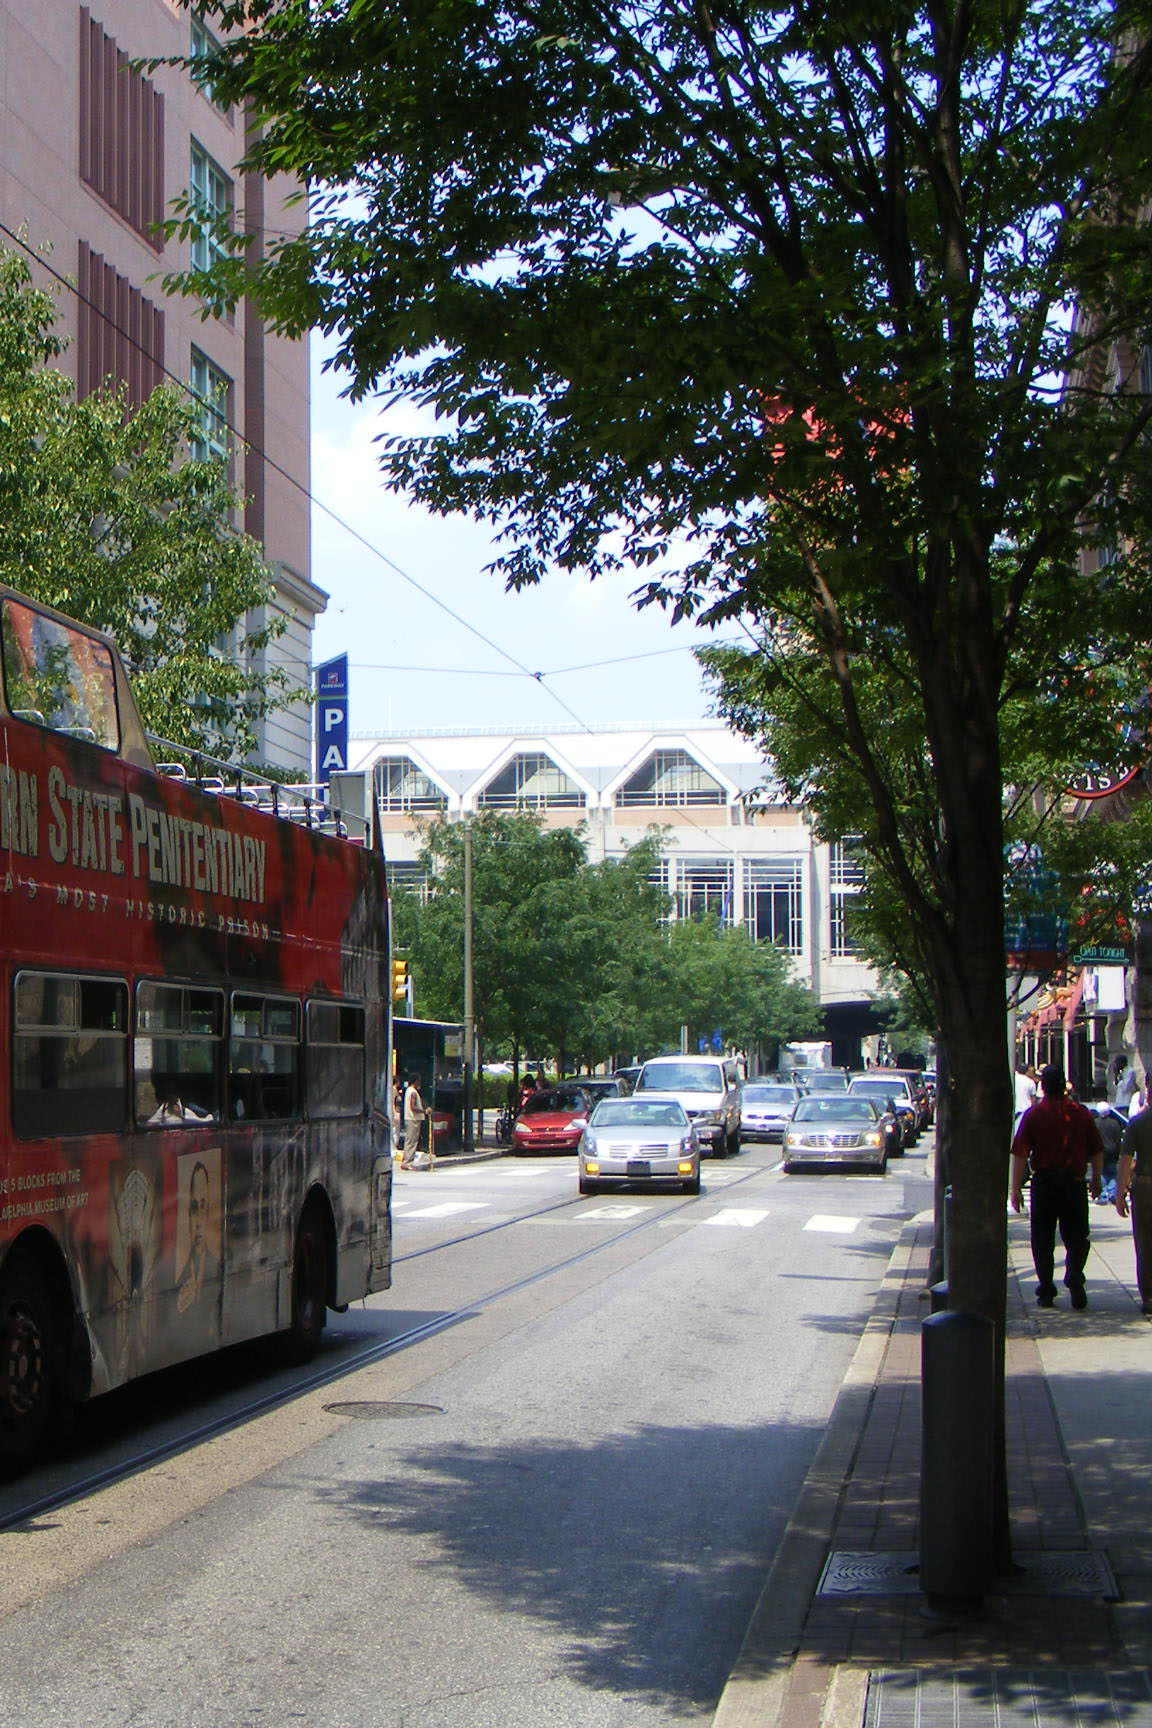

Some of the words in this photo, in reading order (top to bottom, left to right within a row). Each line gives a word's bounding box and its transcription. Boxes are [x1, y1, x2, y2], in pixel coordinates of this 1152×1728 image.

[322, 708, 344, 769] PA
[48, 766, 125, 875] STATE
[128, 792, 266, 904] PENITENTIARY
[56, 883, 109, 913] MOST
[125, 898, 207, 928] HISTORIC
[218, 914, 270, 940] PRISON
[11, 1177, 16, 1192] 5
[17, 1174, 45, 1190] BLOCKS
[69, 1169, 80, 1182] THE
[34, 1196, 66, 1214] MUSEUM
[67, 1194, 75, 1208] OF
[76, 1193, 89, 1206] ART
